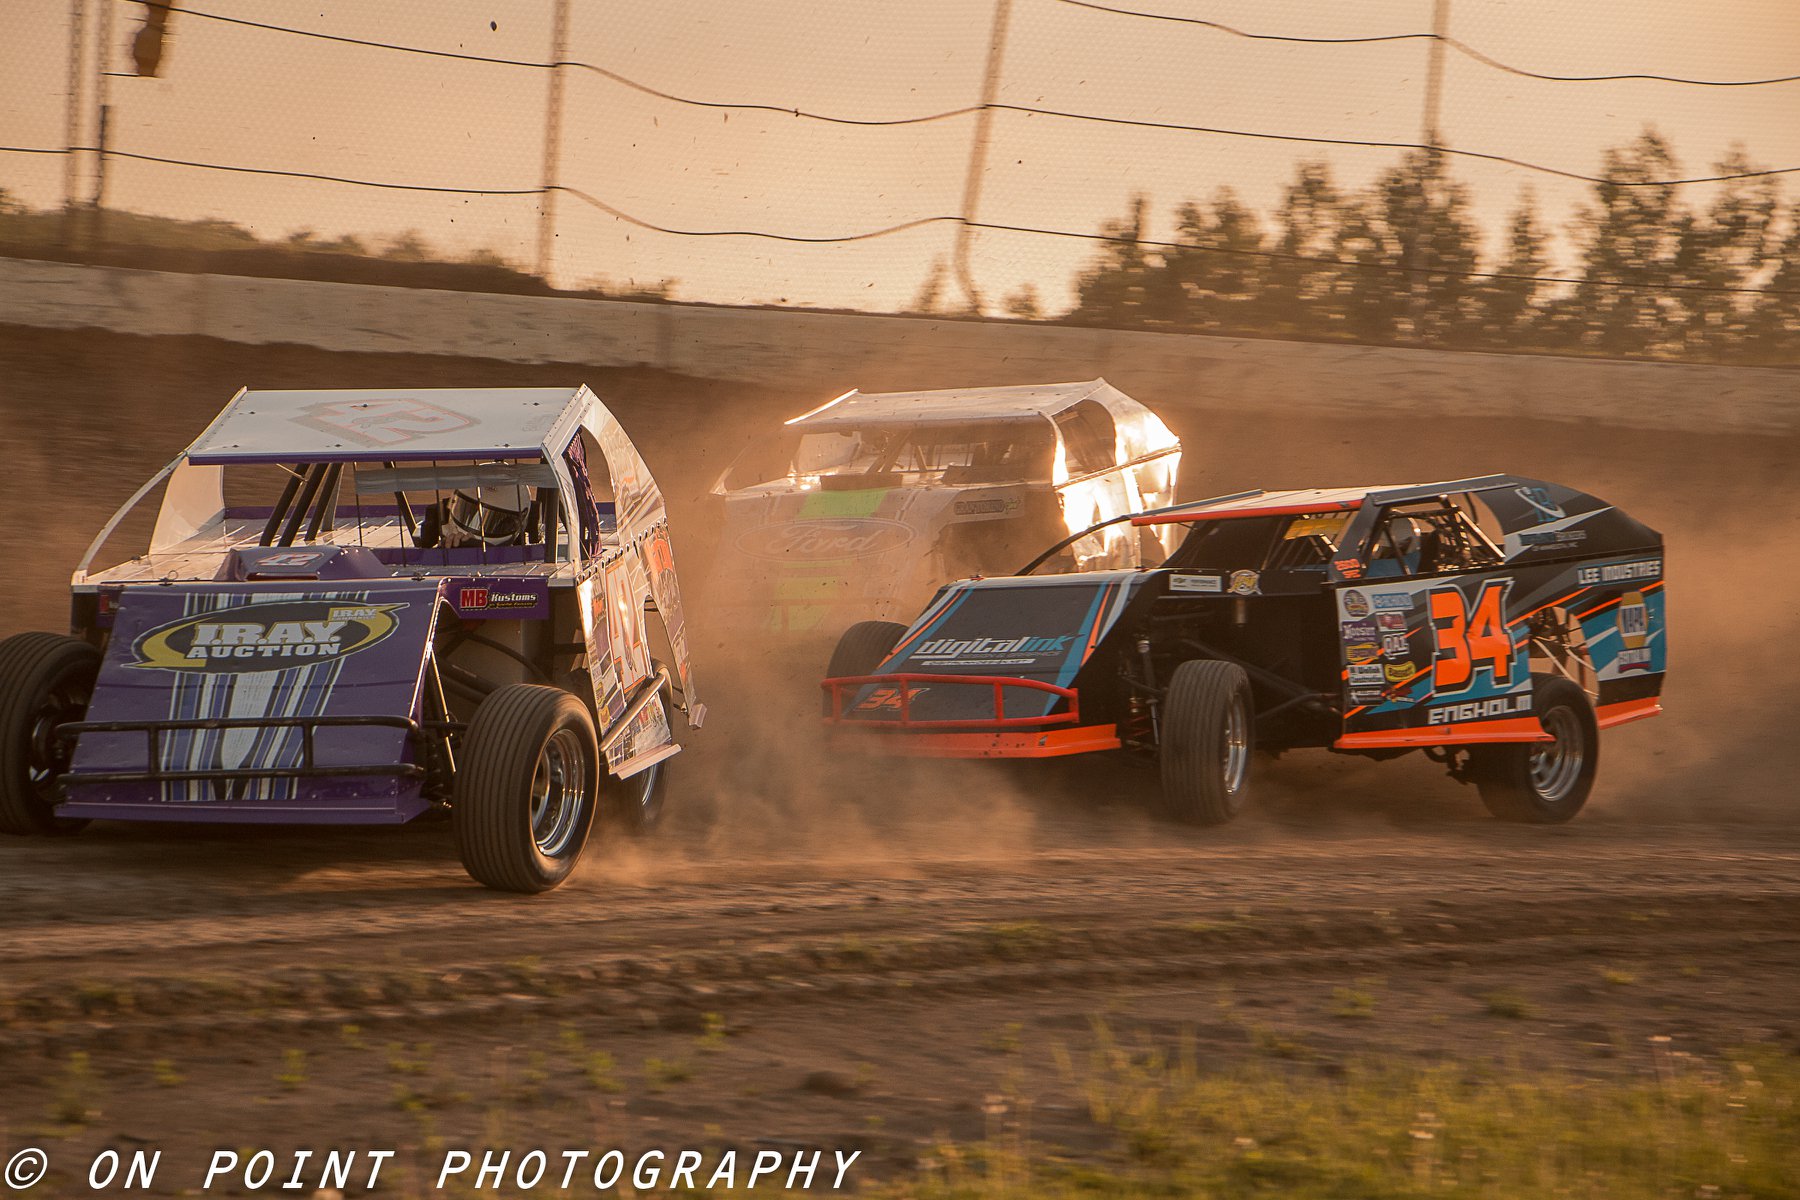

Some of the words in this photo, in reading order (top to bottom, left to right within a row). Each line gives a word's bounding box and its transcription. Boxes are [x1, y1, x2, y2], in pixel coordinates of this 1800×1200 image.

[766, 524, 886, 553] Ford
[1577, 567, 1600, 585] LEE
[1601, 560, 1661, 582] INDUSTRIES
[460, 588, 488, 608] MB
[490, 593, 537, 602] Kustoms
[909, 634, 1076, 660] digitalink
[1427, 578, 1516, 695] 34
[186, 643, 341, 659] AUCTION
[1428, 694, 1532, 725] ENGHOLM
